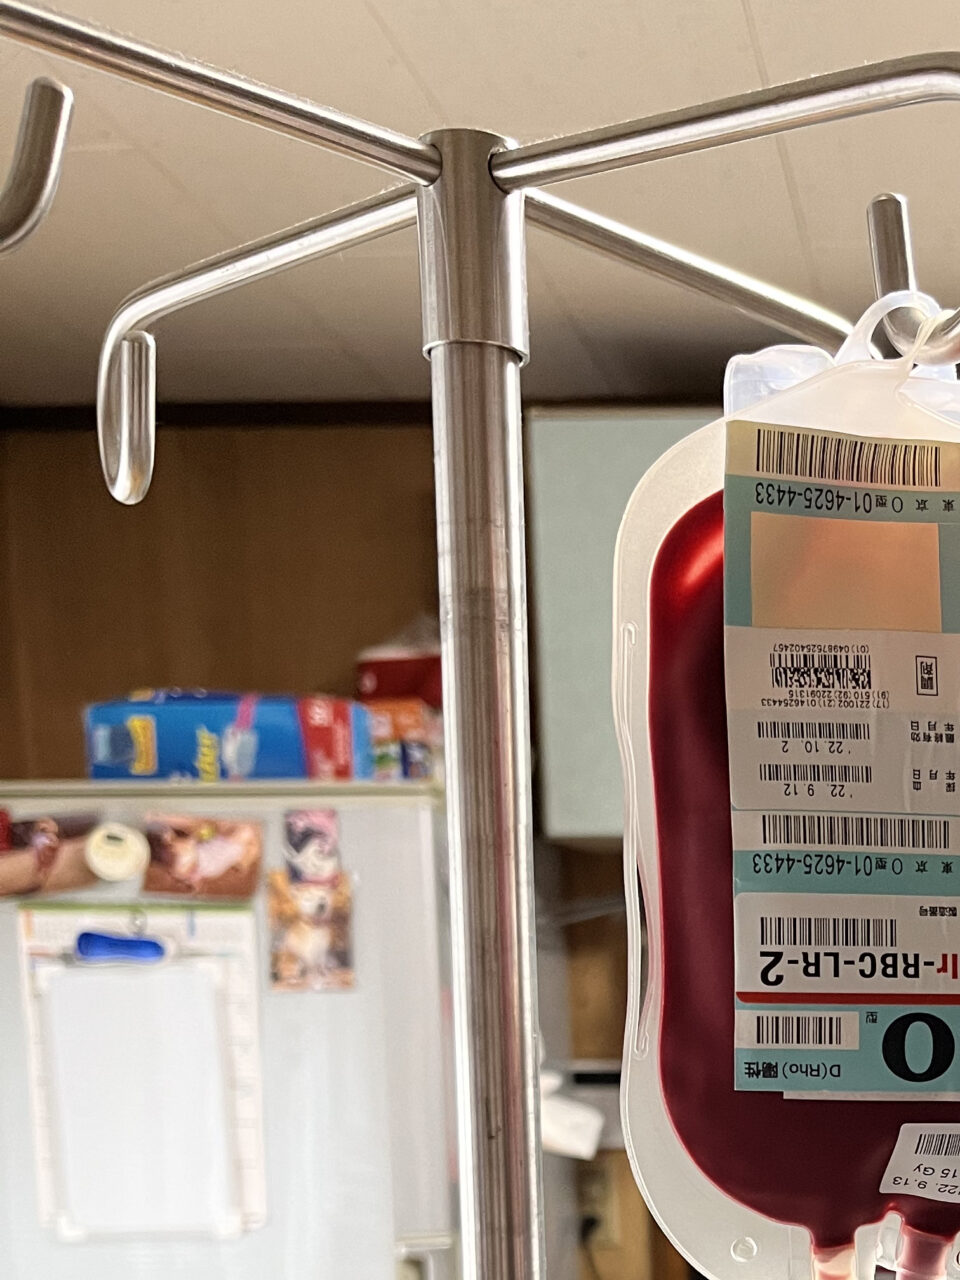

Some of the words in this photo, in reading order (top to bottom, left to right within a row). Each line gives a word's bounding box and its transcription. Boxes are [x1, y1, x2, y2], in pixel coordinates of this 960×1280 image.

[919, 661, 935, 690] 調剤
[919, 906, 958, 917] 製造番号
[760, 951, 958, 987] Ir-RBC-LR-2
[913, 1163, 936, 1177] Gy
[940, 1168, 958, 1178] 15
